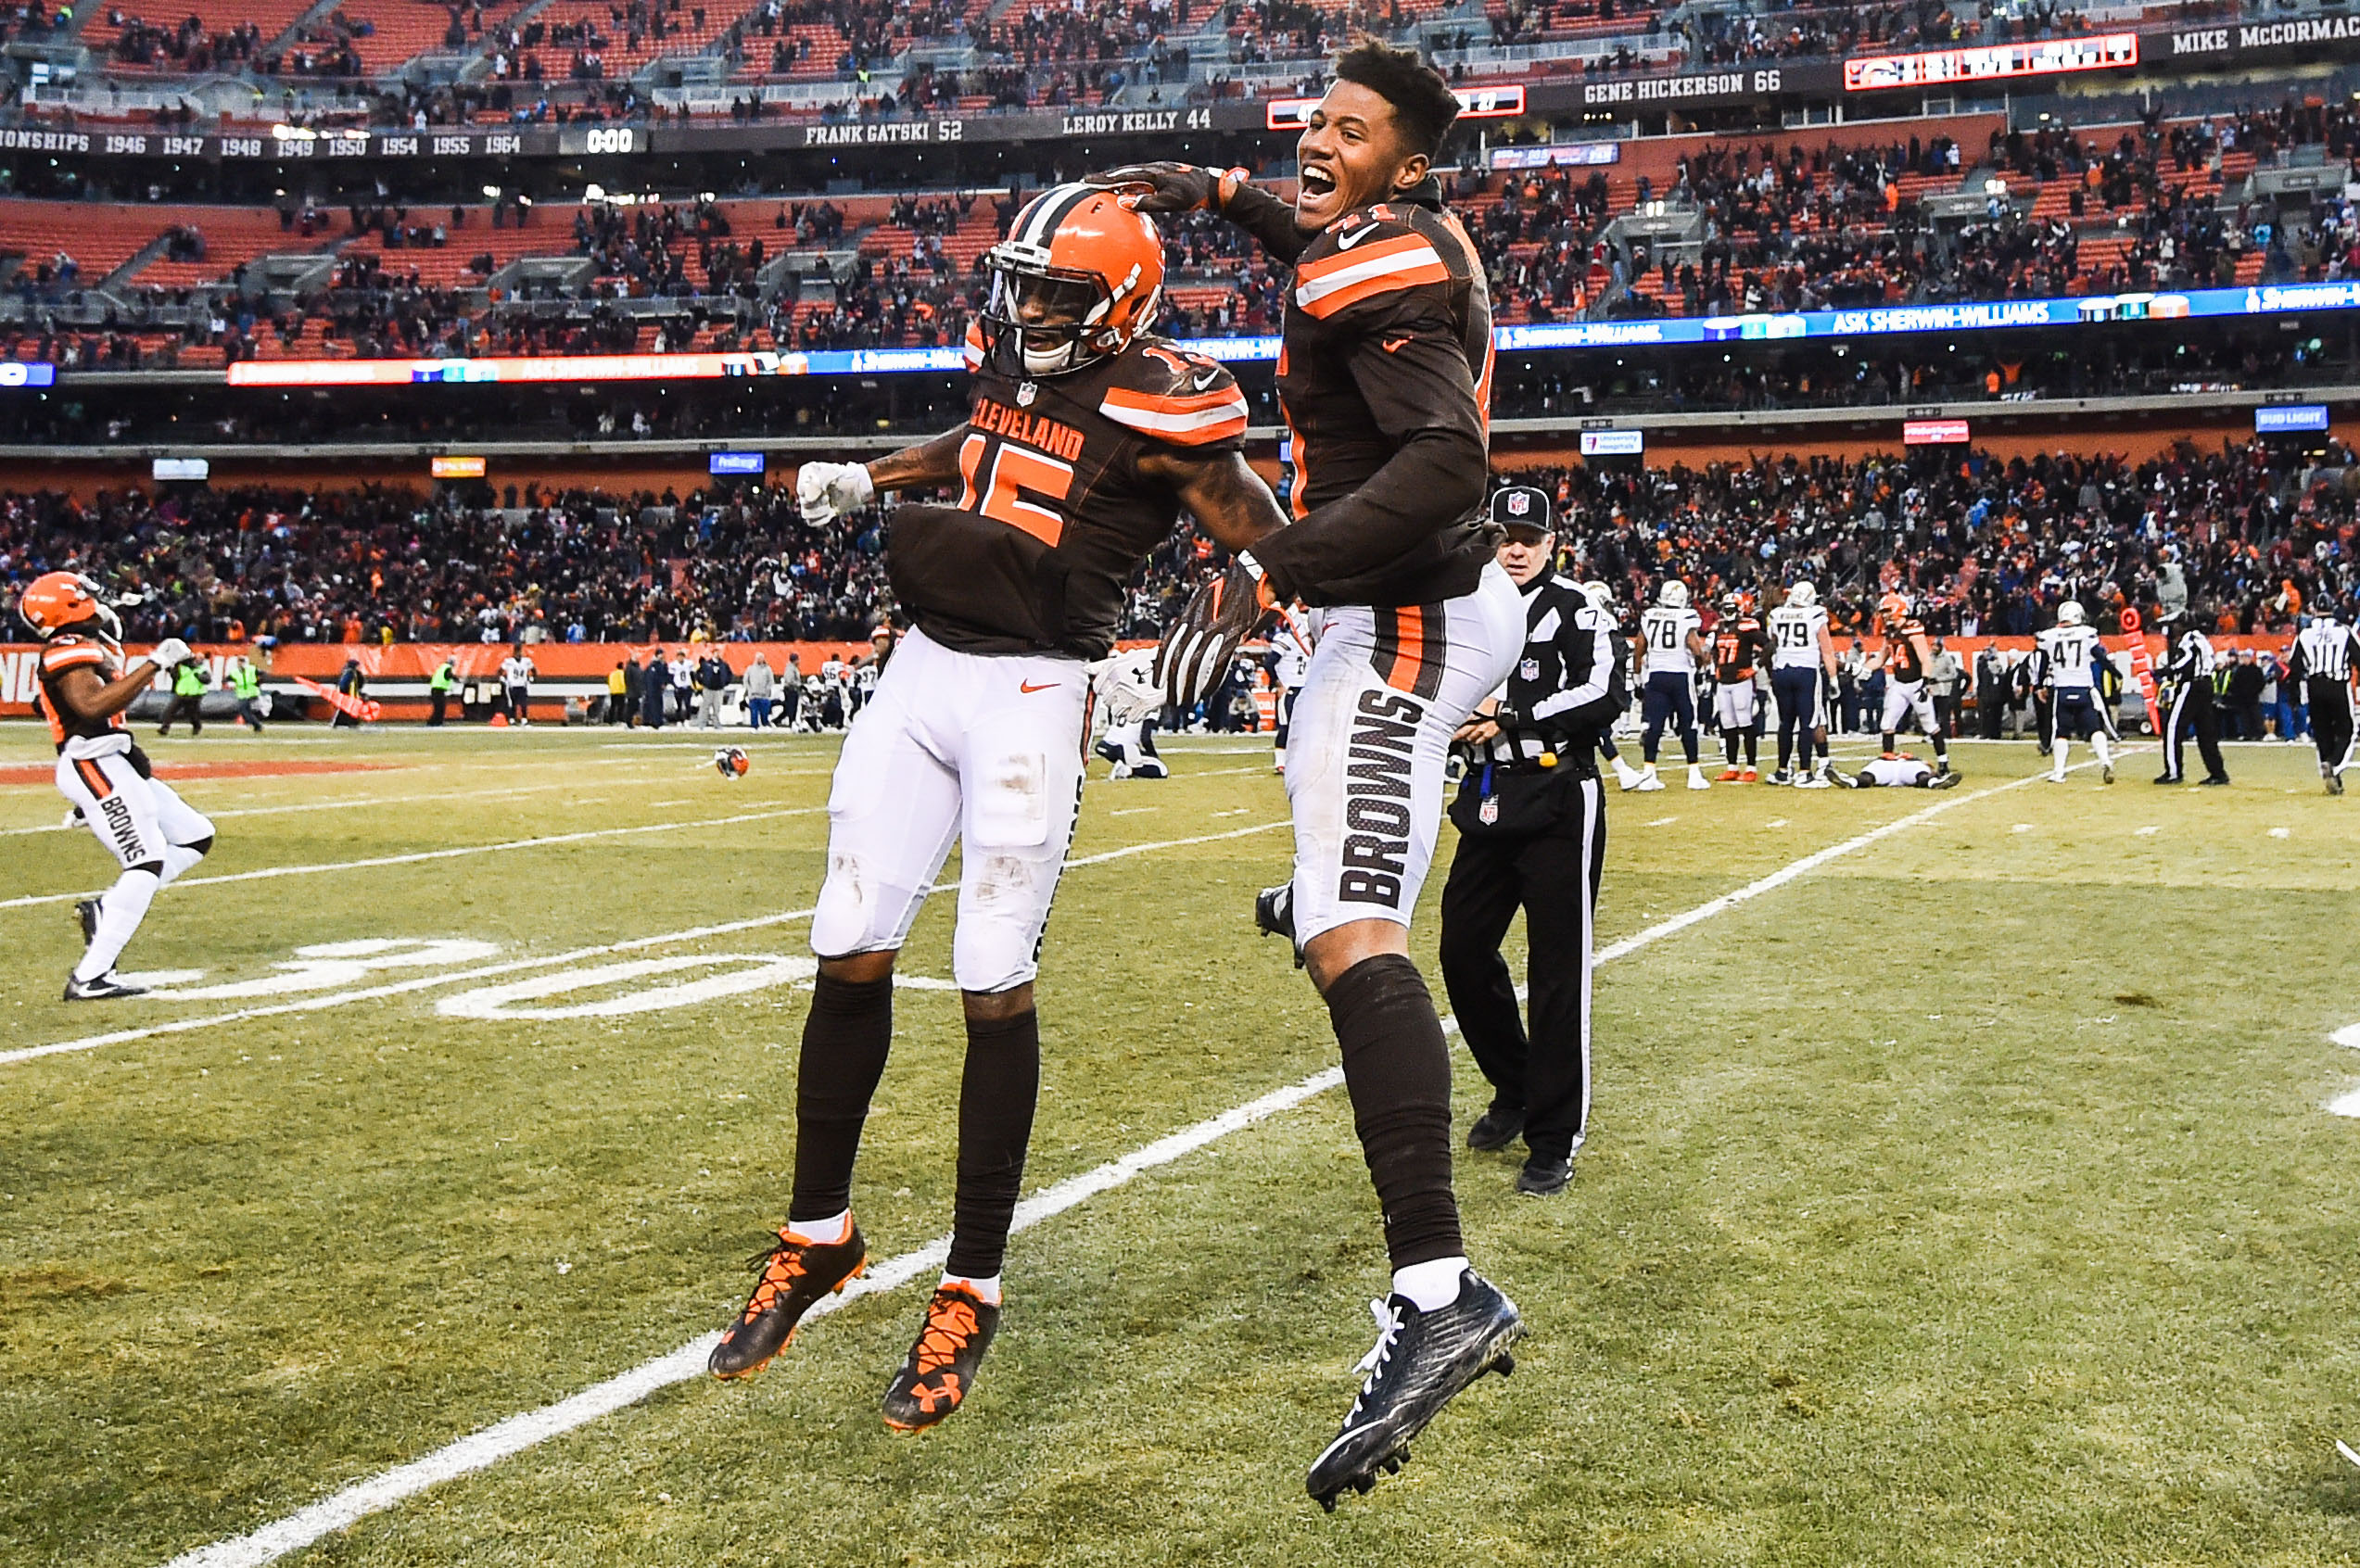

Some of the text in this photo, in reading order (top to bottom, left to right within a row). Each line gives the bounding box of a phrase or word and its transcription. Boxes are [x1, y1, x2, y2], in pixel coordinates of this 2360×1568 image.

[2172, 30, 2228, 54] MIKE
[1584, 70, 1781, 104] GENE HICKERSON 66
[805, 120, 962, 145] FRANK GATSKI 52
[1062, 109, 1212, 135] LEROY KELLY 44
[106, 136, 146, 155] 1946
[162, 137, 203, 155] 1947
[221, 138, 261, 157] 1948
[278, 139, 314, 157] 1949
[329, 138, 366, 157] 1950
[381, 136, 418, 156] 1954
[433, 136, 470, 155] 1955
[485, 135, 521, 154] 1964
[587, 128, 633, 154] 0:00
[1833, 302, 2049, 335] ASK SHERWIN-WILLIAMS
[957, 433, 1073, 549] 15
[1647, 618, 1676, 649] 78
[1777, 622, 1808, 647] 79
[2053, 639, 2082, 668] 47
[1339, 689, 1425, 910] BROWNS
[100, 796, 146, 863] BROWNS
